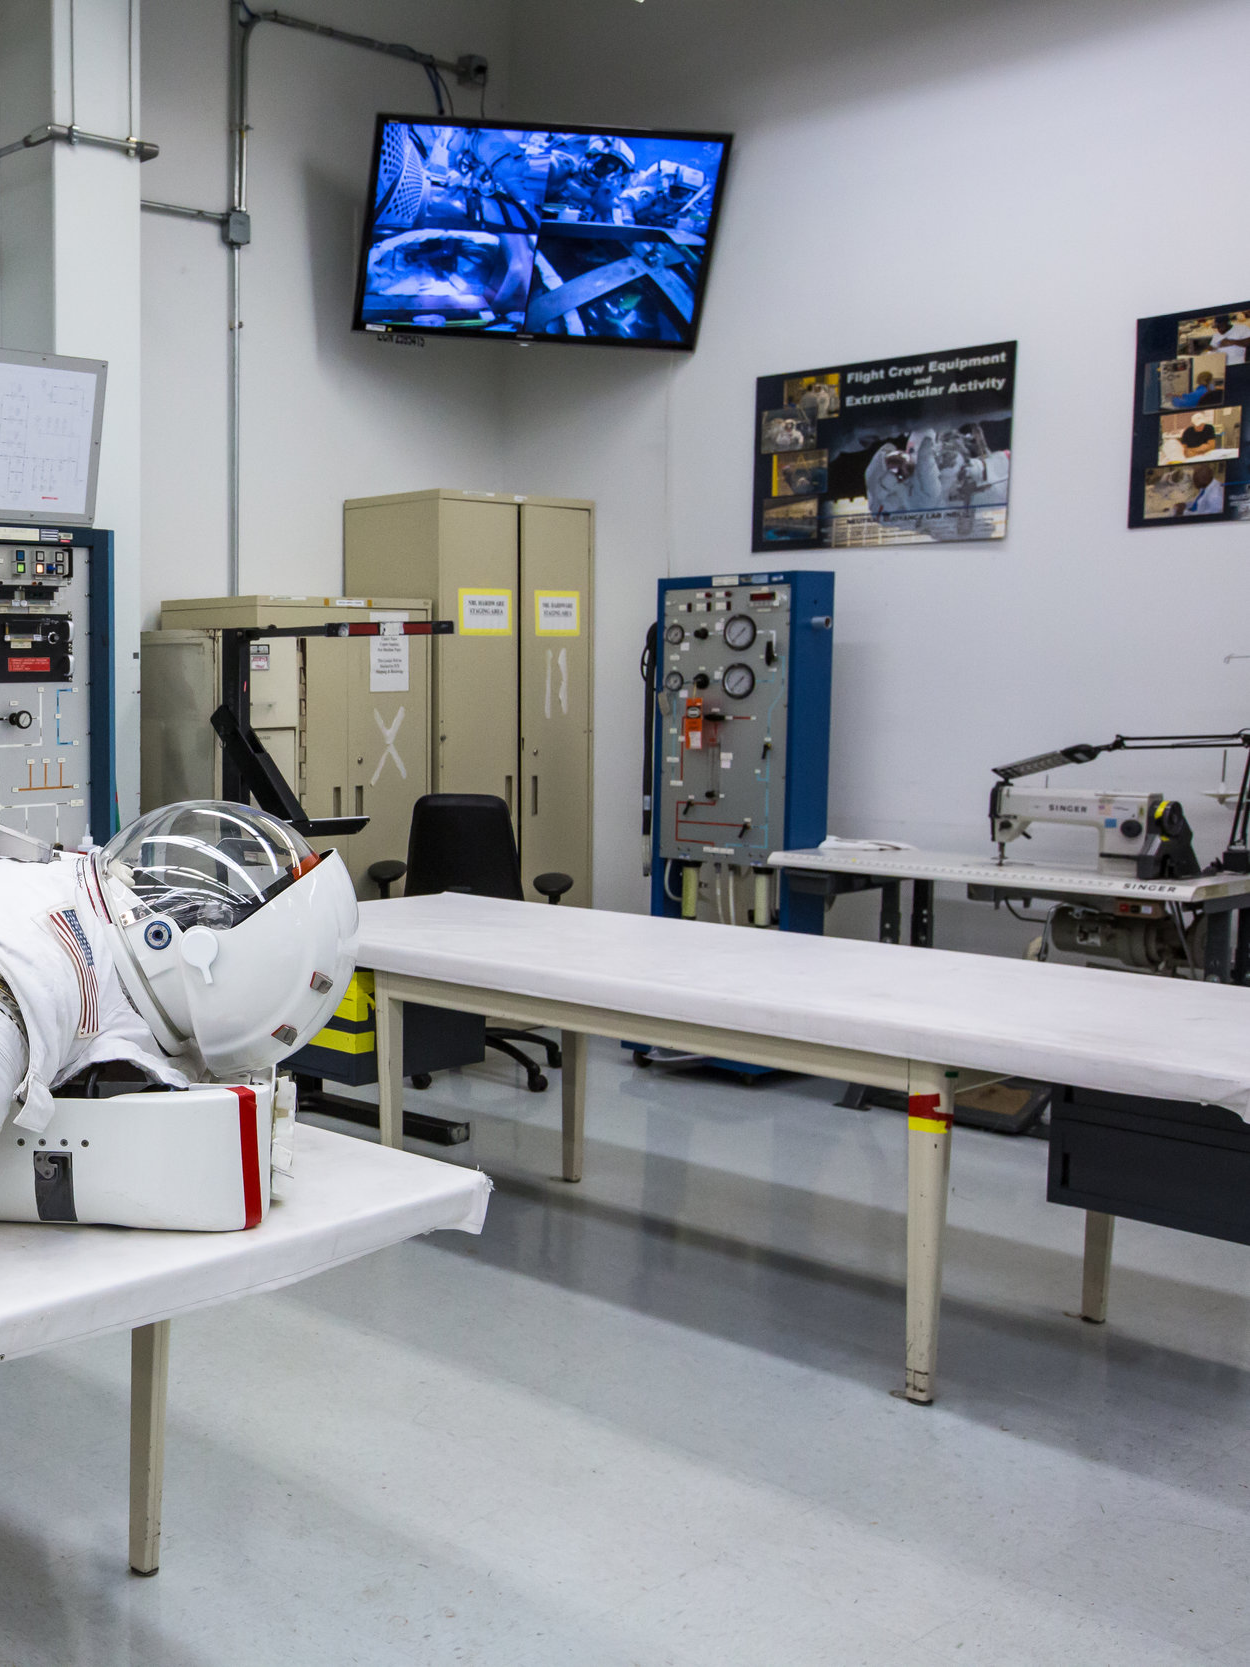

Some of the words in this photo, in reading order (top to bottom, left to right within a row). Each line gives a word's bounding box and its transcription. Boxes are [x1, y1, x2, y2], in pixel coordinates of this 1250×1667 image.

[847, 369, 884, 384] Flight
[888, 364, 925, 378] Crew
[928, 351, 1007, 373] Equipment
[913, 375, 933, 386] and
[845, 385, 945, 407] Extravehicular
[948, 377, 1007, 394] Activity
[1048, 804, 1087, 813] SINGER
[1123, 882, 1176, 892] SINGER
